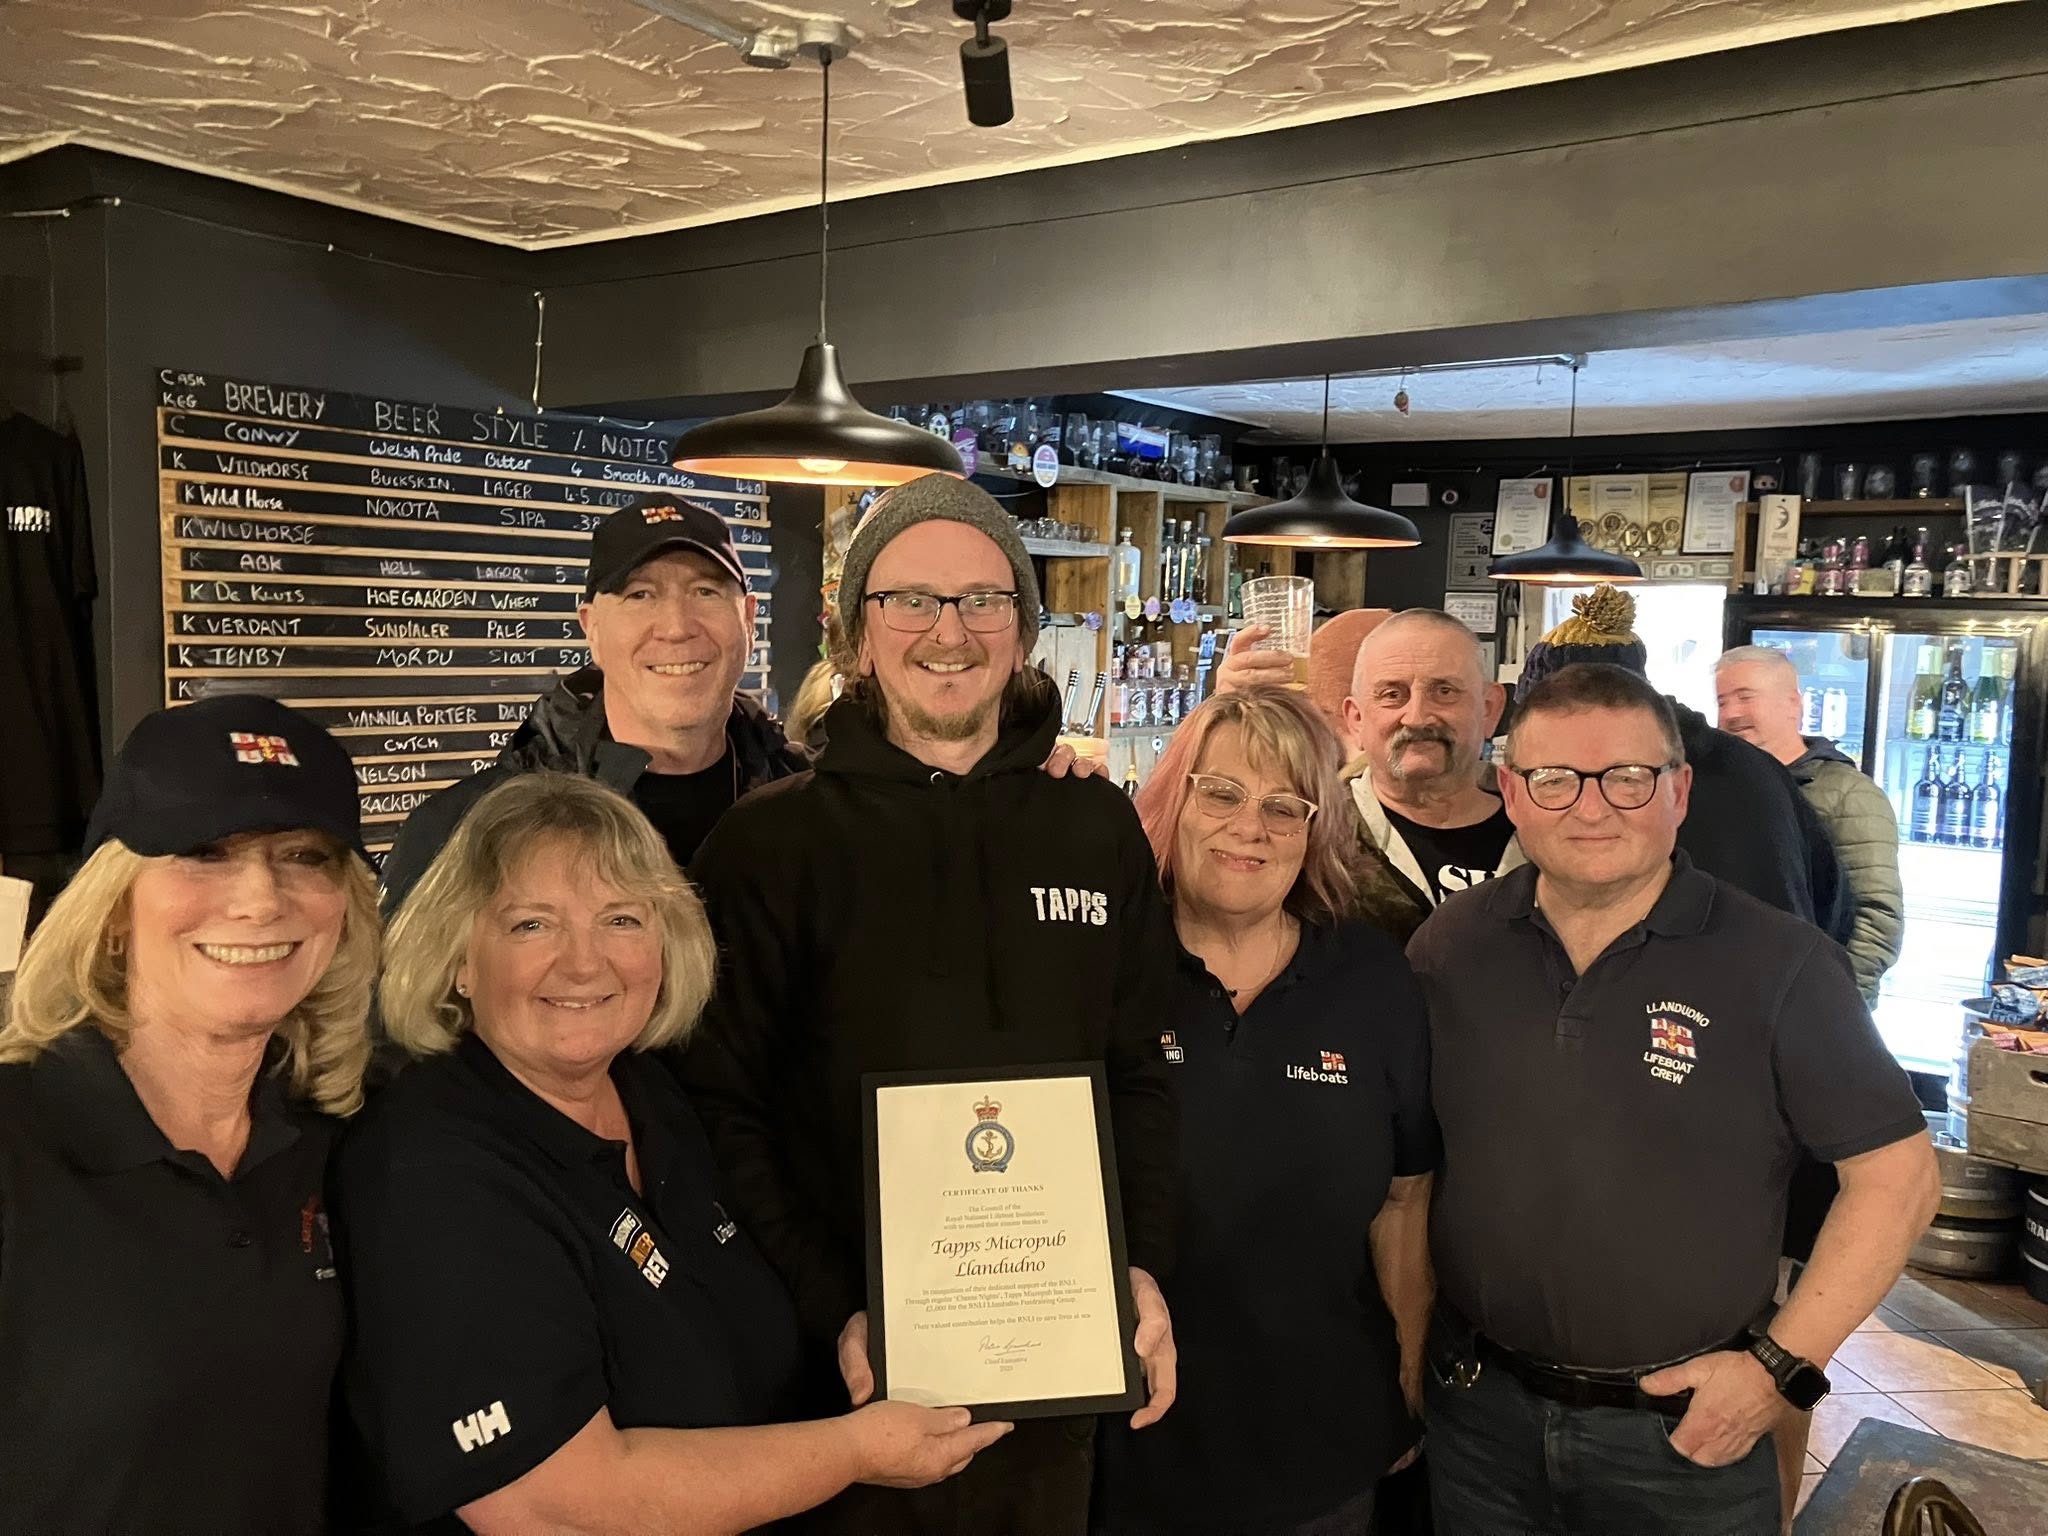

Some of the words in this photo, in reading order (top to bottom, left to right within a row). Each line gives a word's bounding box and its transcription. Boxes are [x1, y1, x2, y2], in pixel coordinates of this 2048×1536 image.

[224, 382, 326, 420] BREWERY
[375, 401, 441, 436] BEER
[472, 413, 549, 449] STYLE
[601, 433, 669, 465] NOTES
[170, 415, 185, 434] C
[369, 440, 420, 461] Welsh
[424, 445, 462, 464] Pride
[484, 452, 533, 472] Bitter
[570, 462, 583, 477] 4
[172, 452, 187, 470] K
[216, 454, 310, 482] WILDHORSE
[483, 480, 533, 500] LAGER
[184, 484, 196, 502] K
[200, 486, 241, 508] Wild
[246, 487, 284, 512] Horse
[365, 499, 440, 521] NOKOTA
[182, 517, 196, 538] K
[189, 551, 204, 569] K
[240, 553, 284, 572] ABK
[555, 566, 567, 584] 5
[189, 583, 204, 599] K
[366, 588, 478, 609] HOEGAARDEN
[182, 614, 196, 633] K
[206, 617, 302, 636] VERDANT
[364, 617, 450, 639] SUNDIALER
[486, 619, 527, 640] PALE
[562, 621, 574, 639] 5
[178, 646, 193, 667] K
[427, 649, 454, 665] DU
[178, 680, 191, 698] K
[416, 705, 478, 725] PORTER
[1030, 887, 1108, 926] TAPPS
[1645, 1000, 1711, 1028] LLANDUDNO
[1286, 1064, 1349, 1085] Lifeboats
[1643, 1051, 1695, 1075] LIFEBOAT
[1650, 1065, 1685, 1085] CREW
[942, 1187, 997, 1198] CERTIFICATE
[998, 1185, 1010, 1195] OF
[1011, 1184, 1045, 1194] THANKS
[931, 1237, 982, 1259] Tapps
[984, 1229, 1067, 1252] Micropub
[954, 1255, 1046, 1278] Llandudno
[452, 1400, 512, 1453] HH
